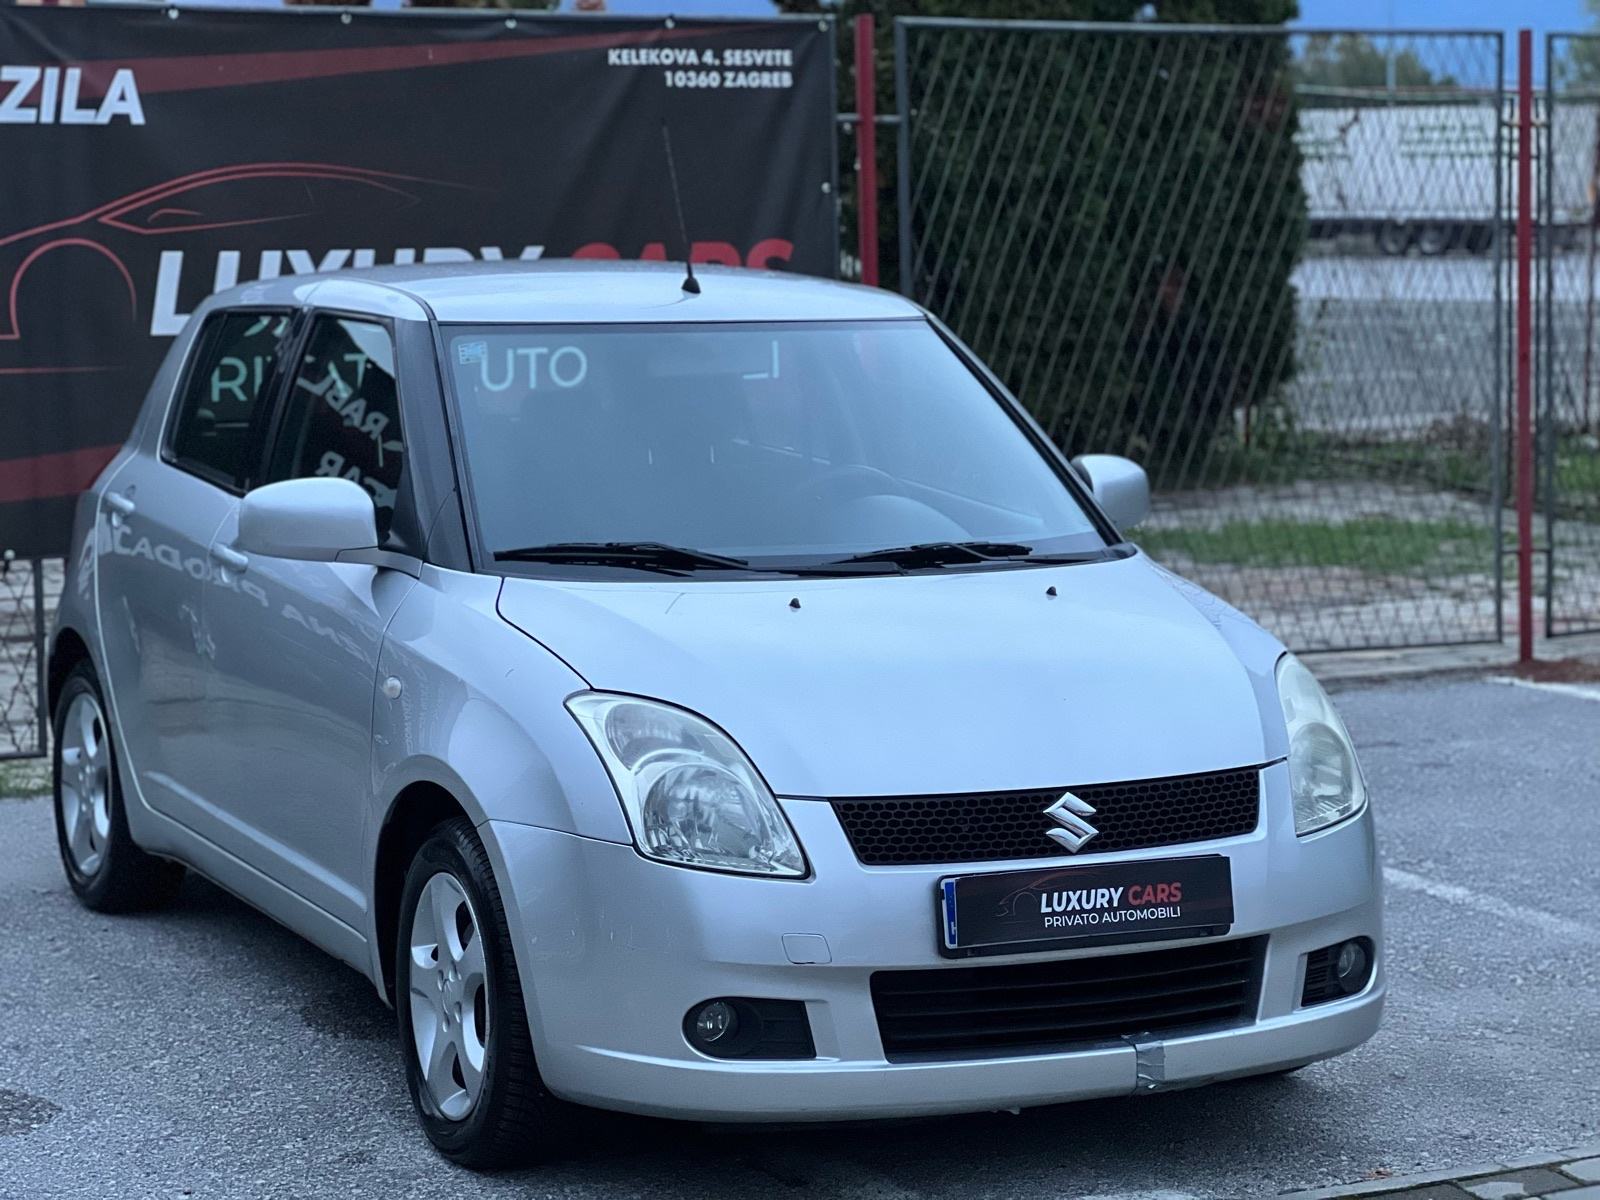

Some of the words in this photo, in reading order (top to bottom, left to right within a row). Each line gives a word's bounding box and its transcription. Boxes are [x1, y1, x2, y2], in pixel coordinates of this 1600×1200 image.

[607, 48, 700, 66] KELEKOVA
[722, 49, 794, 67] SESVETE
[664, 70, 721, 88] 10360
[723, 71, 794, 88] ZAGREB
[0, 64, 146, 125] ZILA
[1040, 886, 1124, 913] LUXURY
[1127, 882, 1182, 906] CARS
[1044, 912, 1100, 928] PRIVATO
[1101, 905, 1181, 923] AUTOMOBILI
